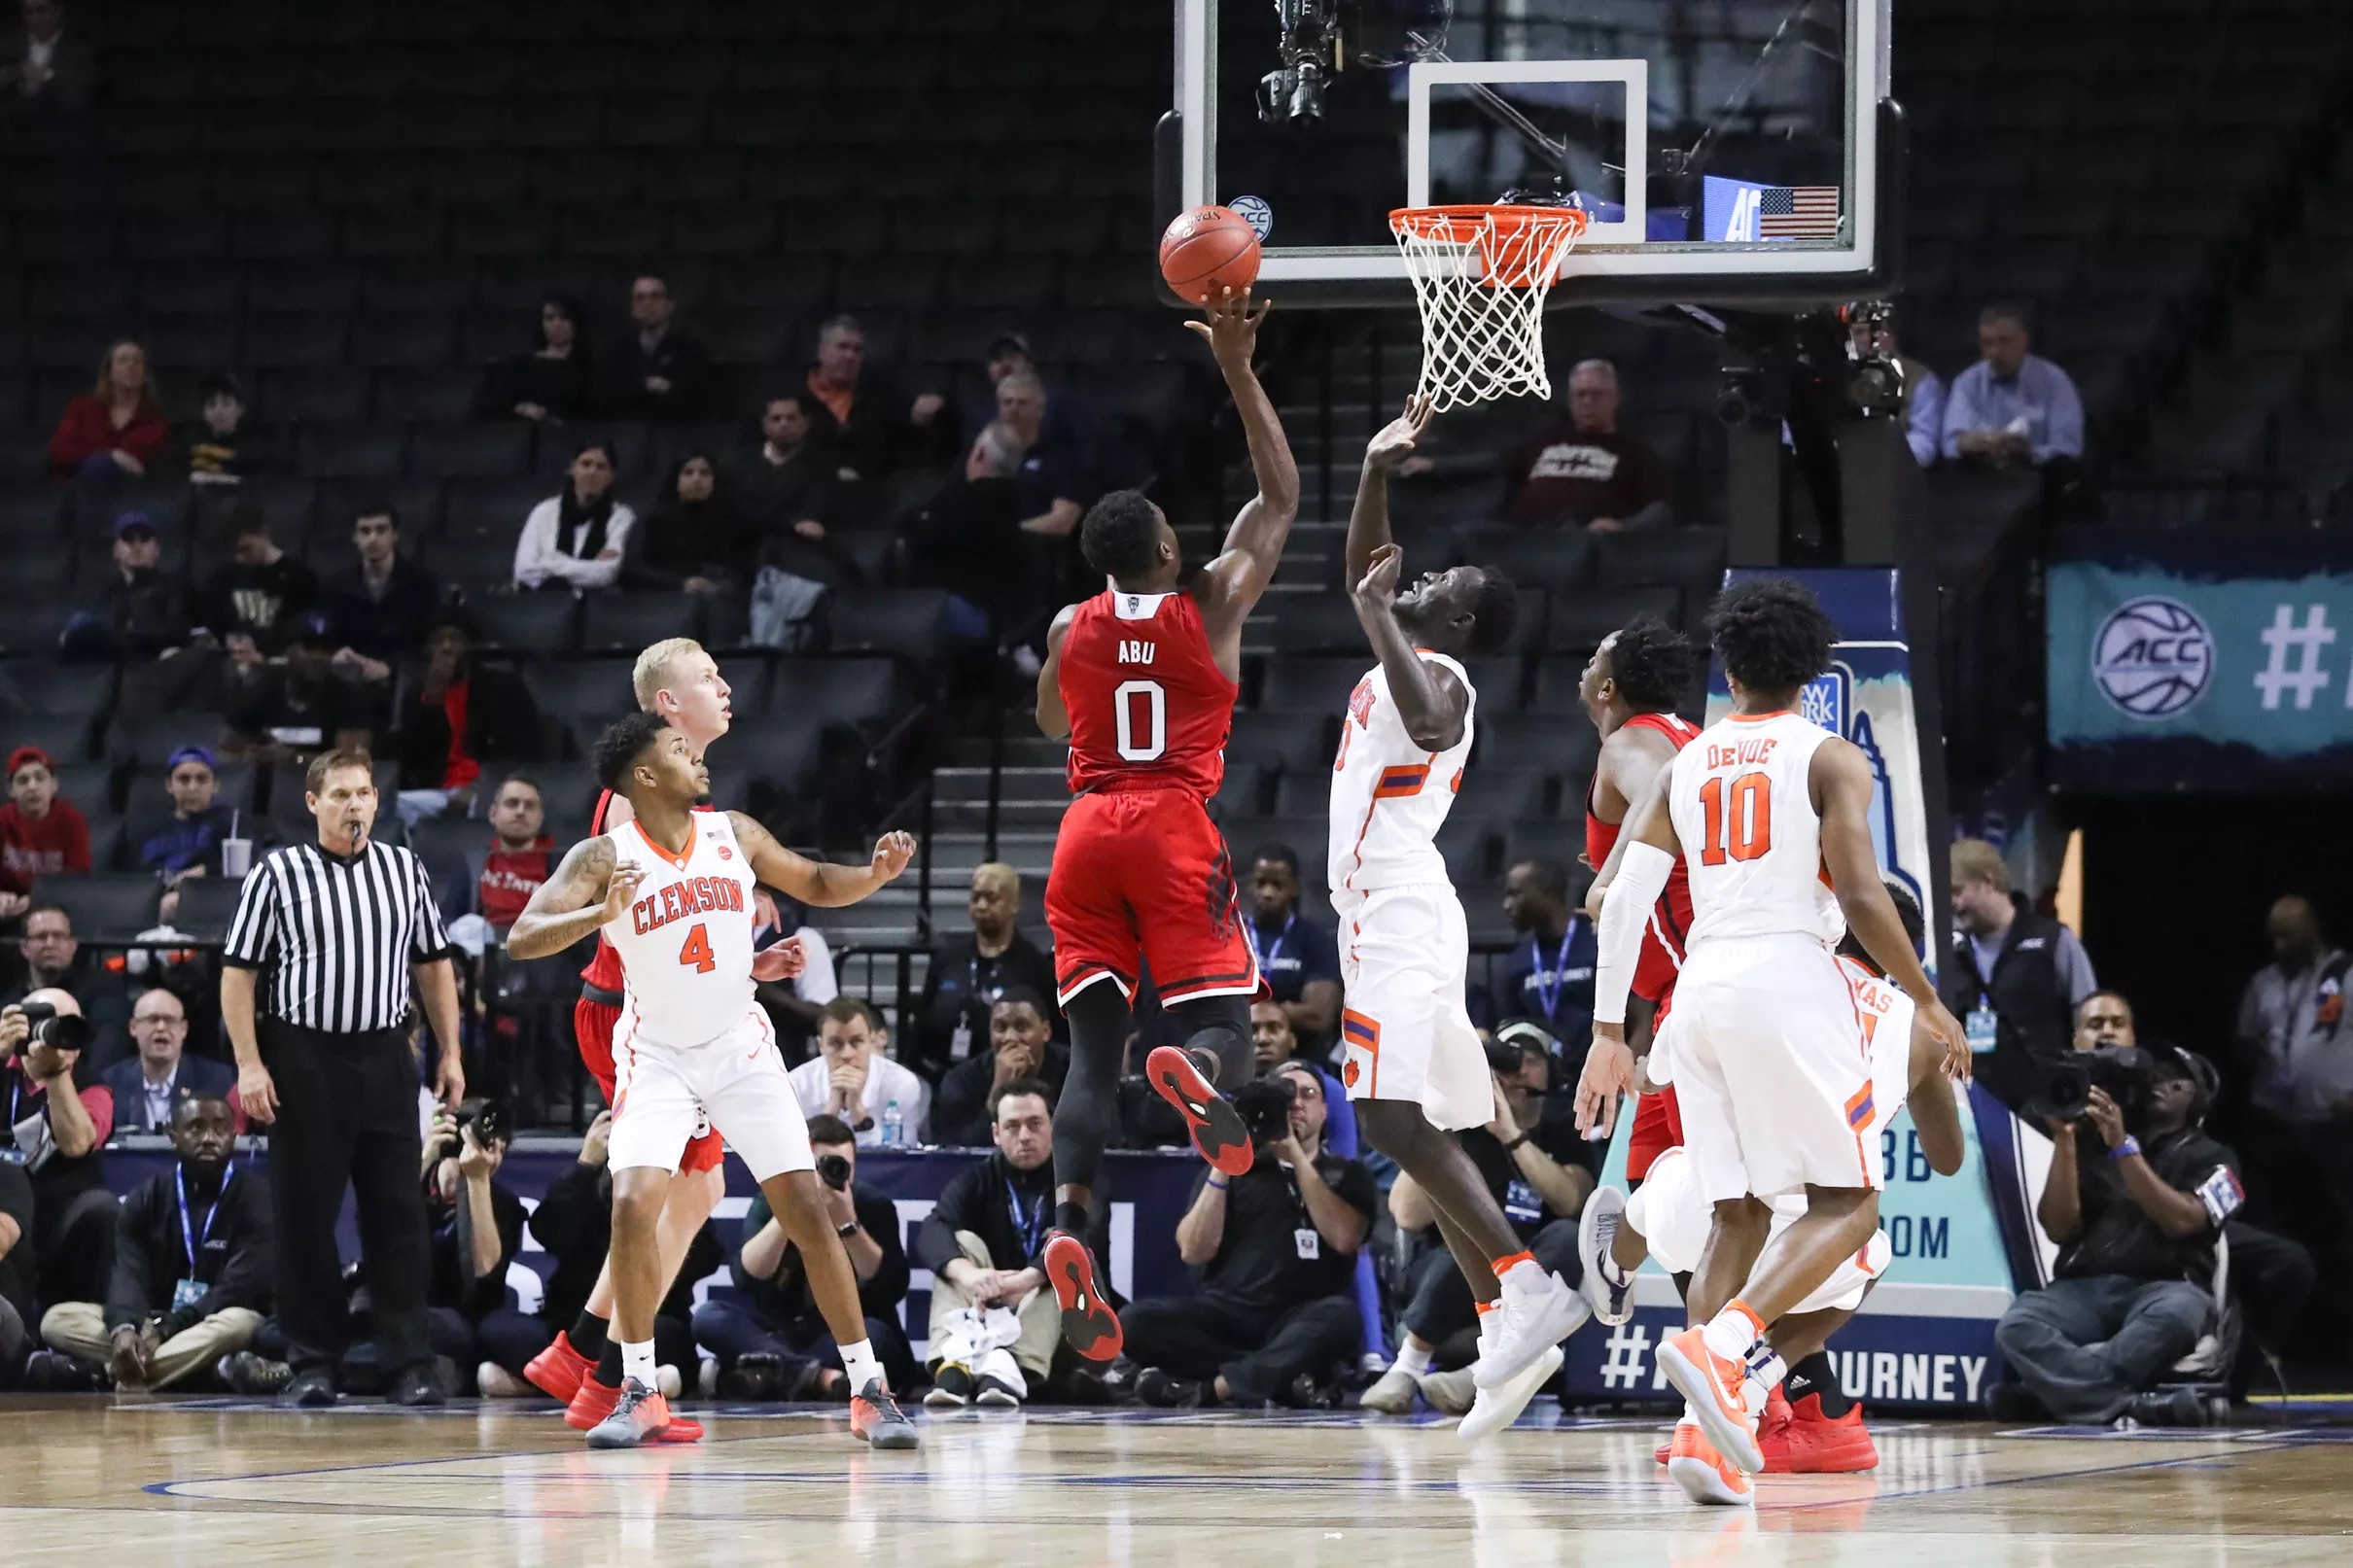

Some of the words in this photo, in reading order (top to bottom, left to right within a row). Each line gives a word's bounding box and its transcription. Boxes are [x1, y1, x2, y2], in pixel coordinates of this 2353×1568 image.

[1118, 640, 1155, 665] ABU
[2113, 637, 2203, 665] ACC
[1114, 680, 1166, 761] 0
[1699, 771, 1773, 867] 10
[632, 876, 745, 936] CLEMSON
[680, 923, 716, 974] 4
